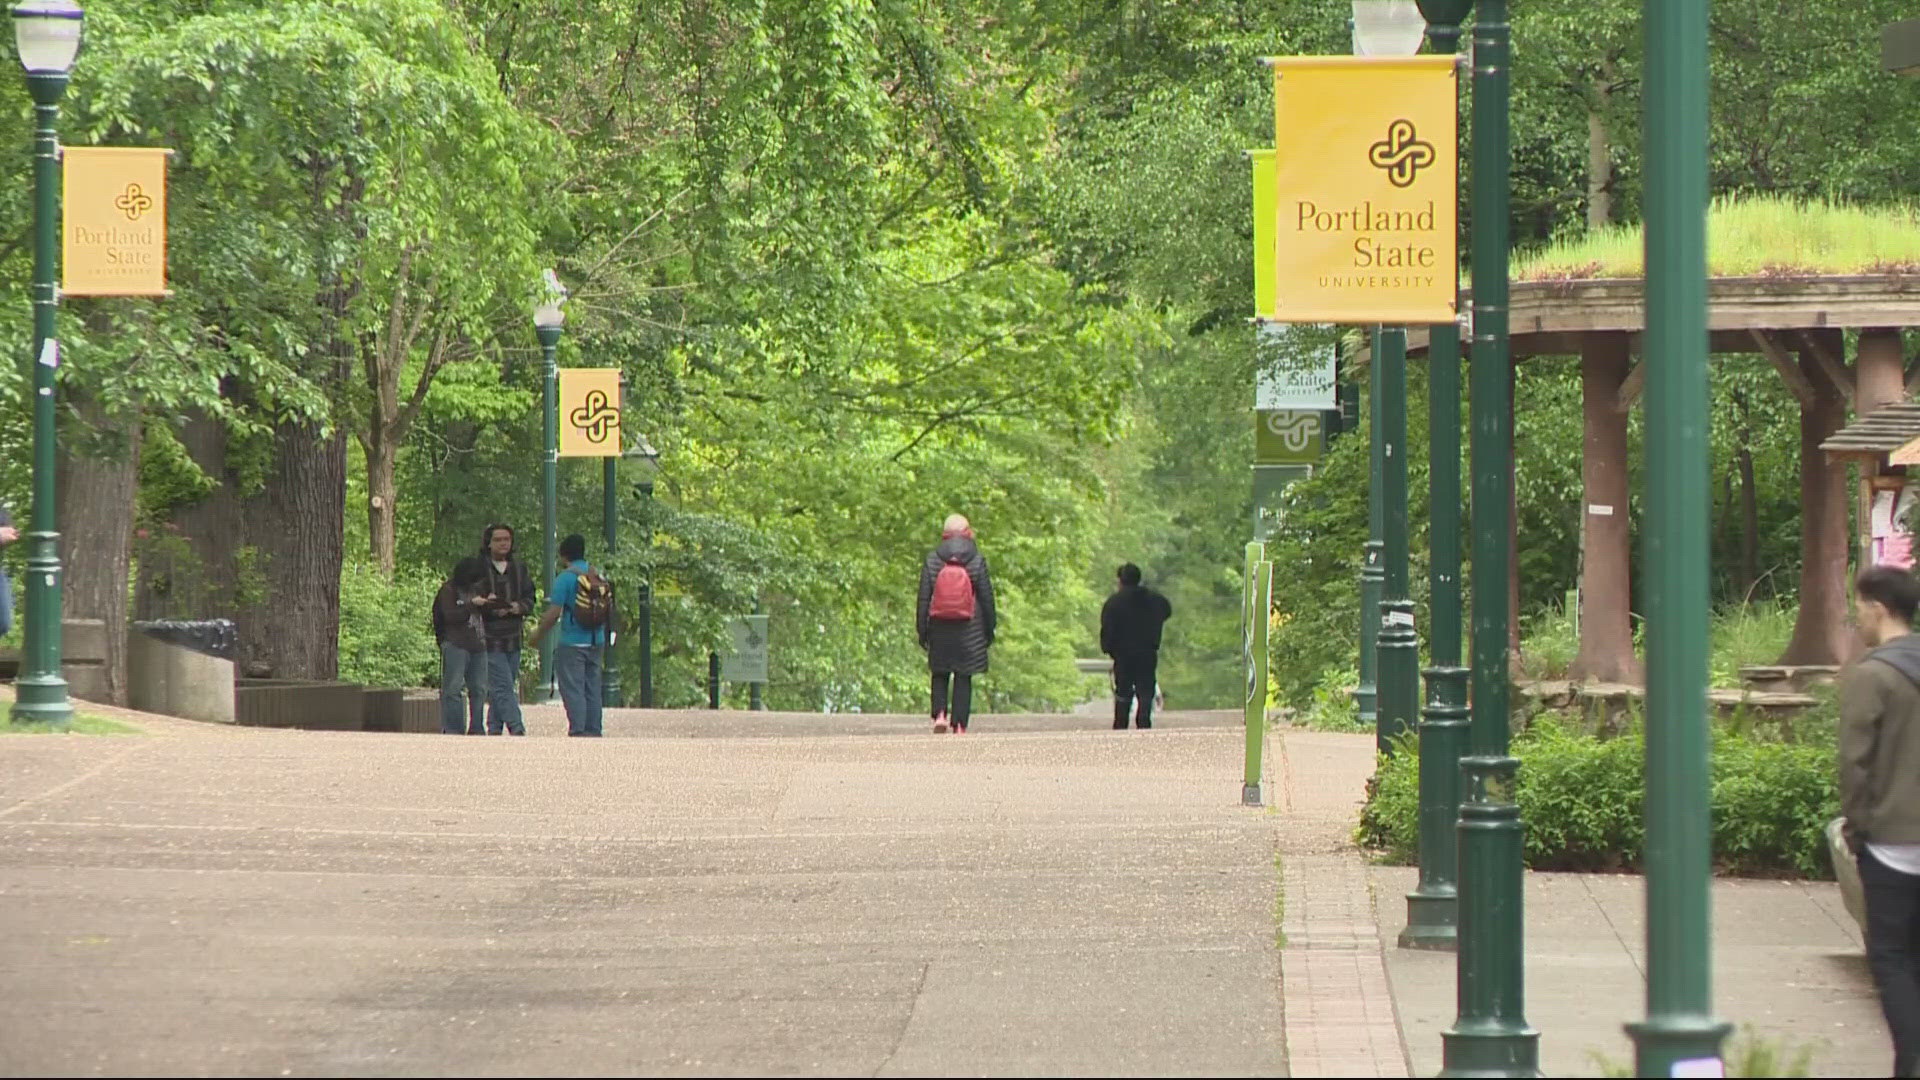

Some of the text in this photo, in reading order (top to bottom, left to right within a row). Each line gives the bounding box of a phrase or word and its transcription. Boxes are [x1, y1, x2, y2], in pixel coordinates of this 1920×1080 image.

[1296, 200, 1435, 231] Portland
[74, 226, 152, 245] Portland
[106, 246, 151, 264] State
[1354, 237, 1434, 267] State
[1319, 276, 1433, 287] UNIVERSITY
